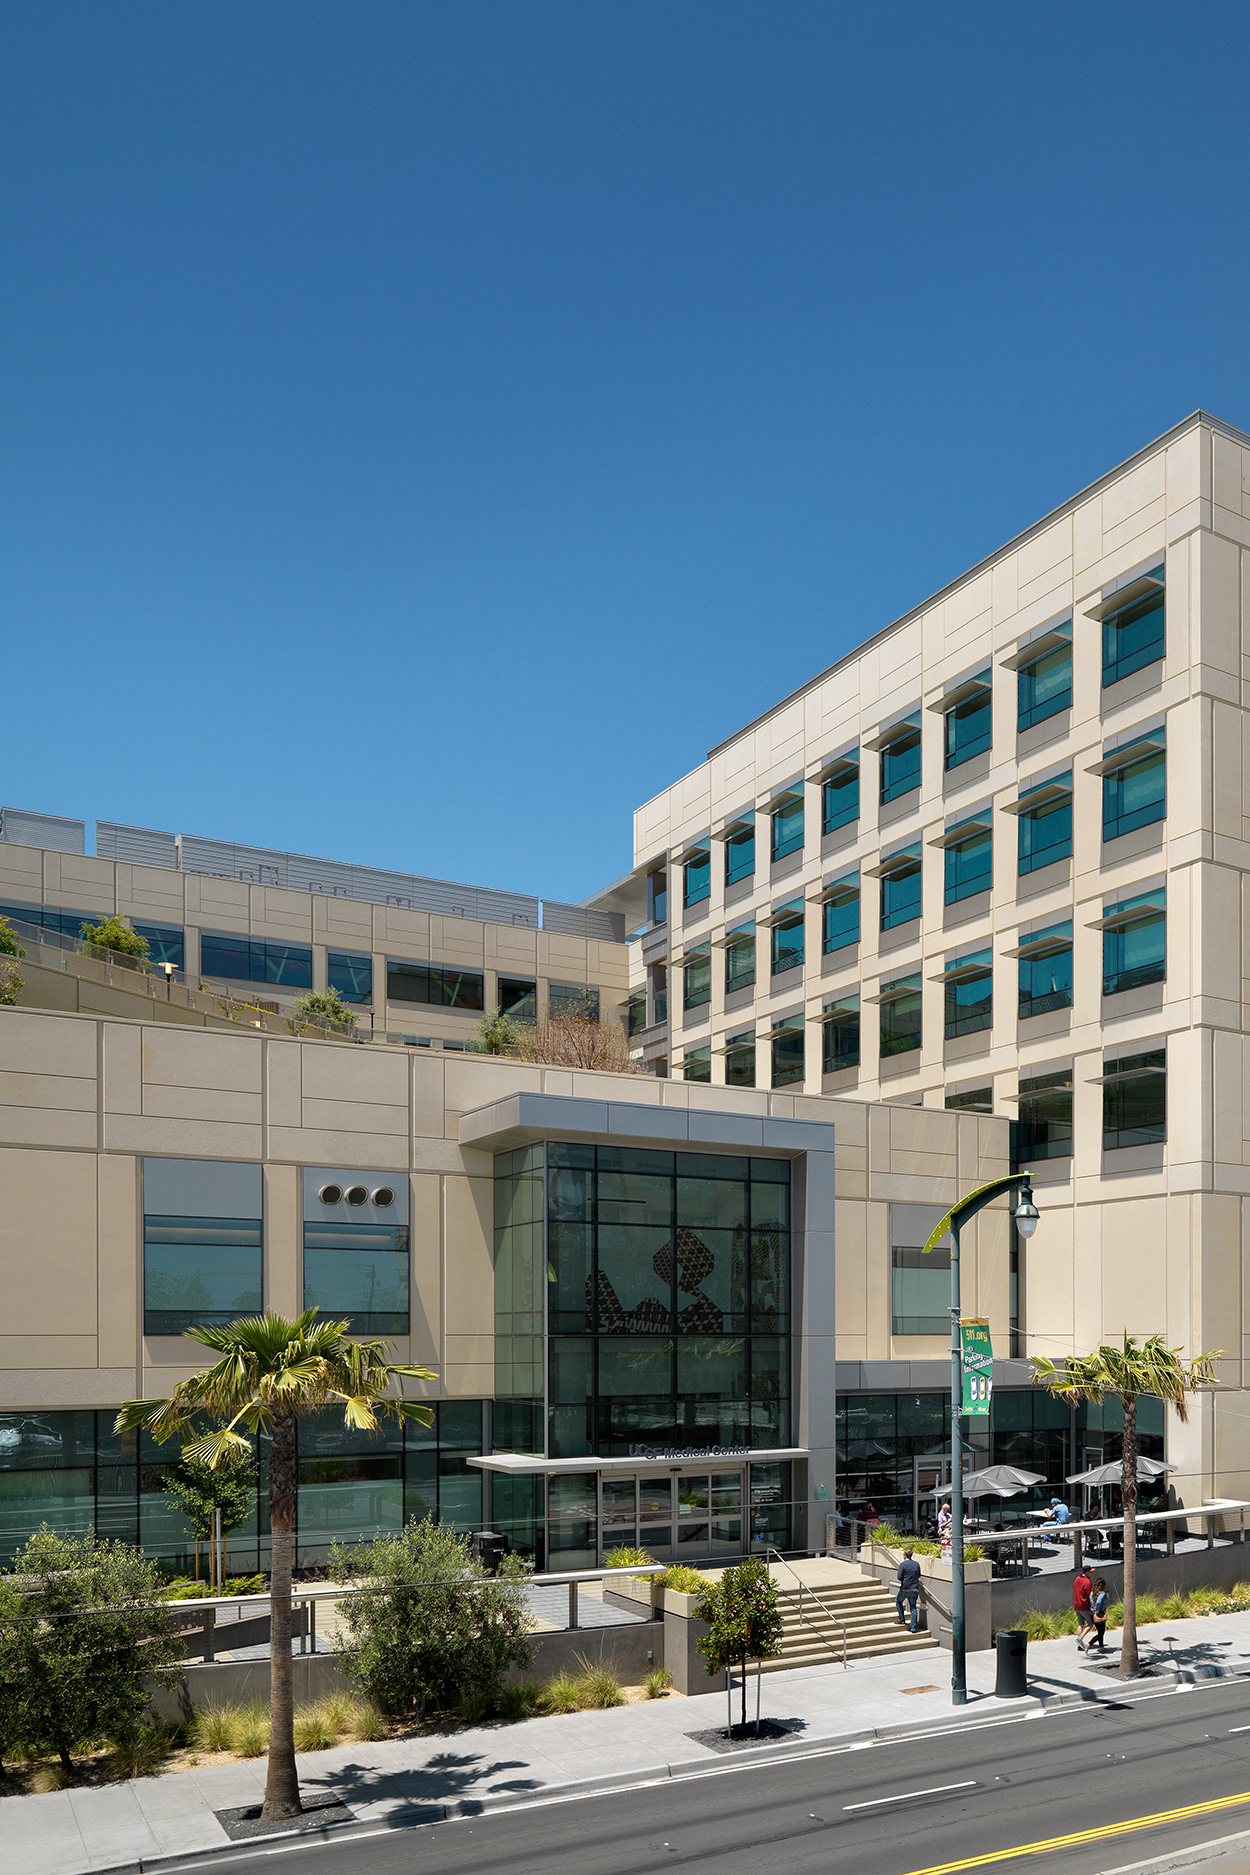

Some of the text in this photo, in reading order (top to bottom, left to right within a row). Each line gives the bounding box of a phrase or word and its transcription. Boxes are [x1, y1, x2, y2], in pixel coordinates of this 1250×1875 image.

[966, 1329, 988, 1342] 511.org
[965, 1352, 983, 1363] Parking
[964, 1357, 993, 1373] Information
[629, 1444, 750, 1459] UCSF Medical Center
